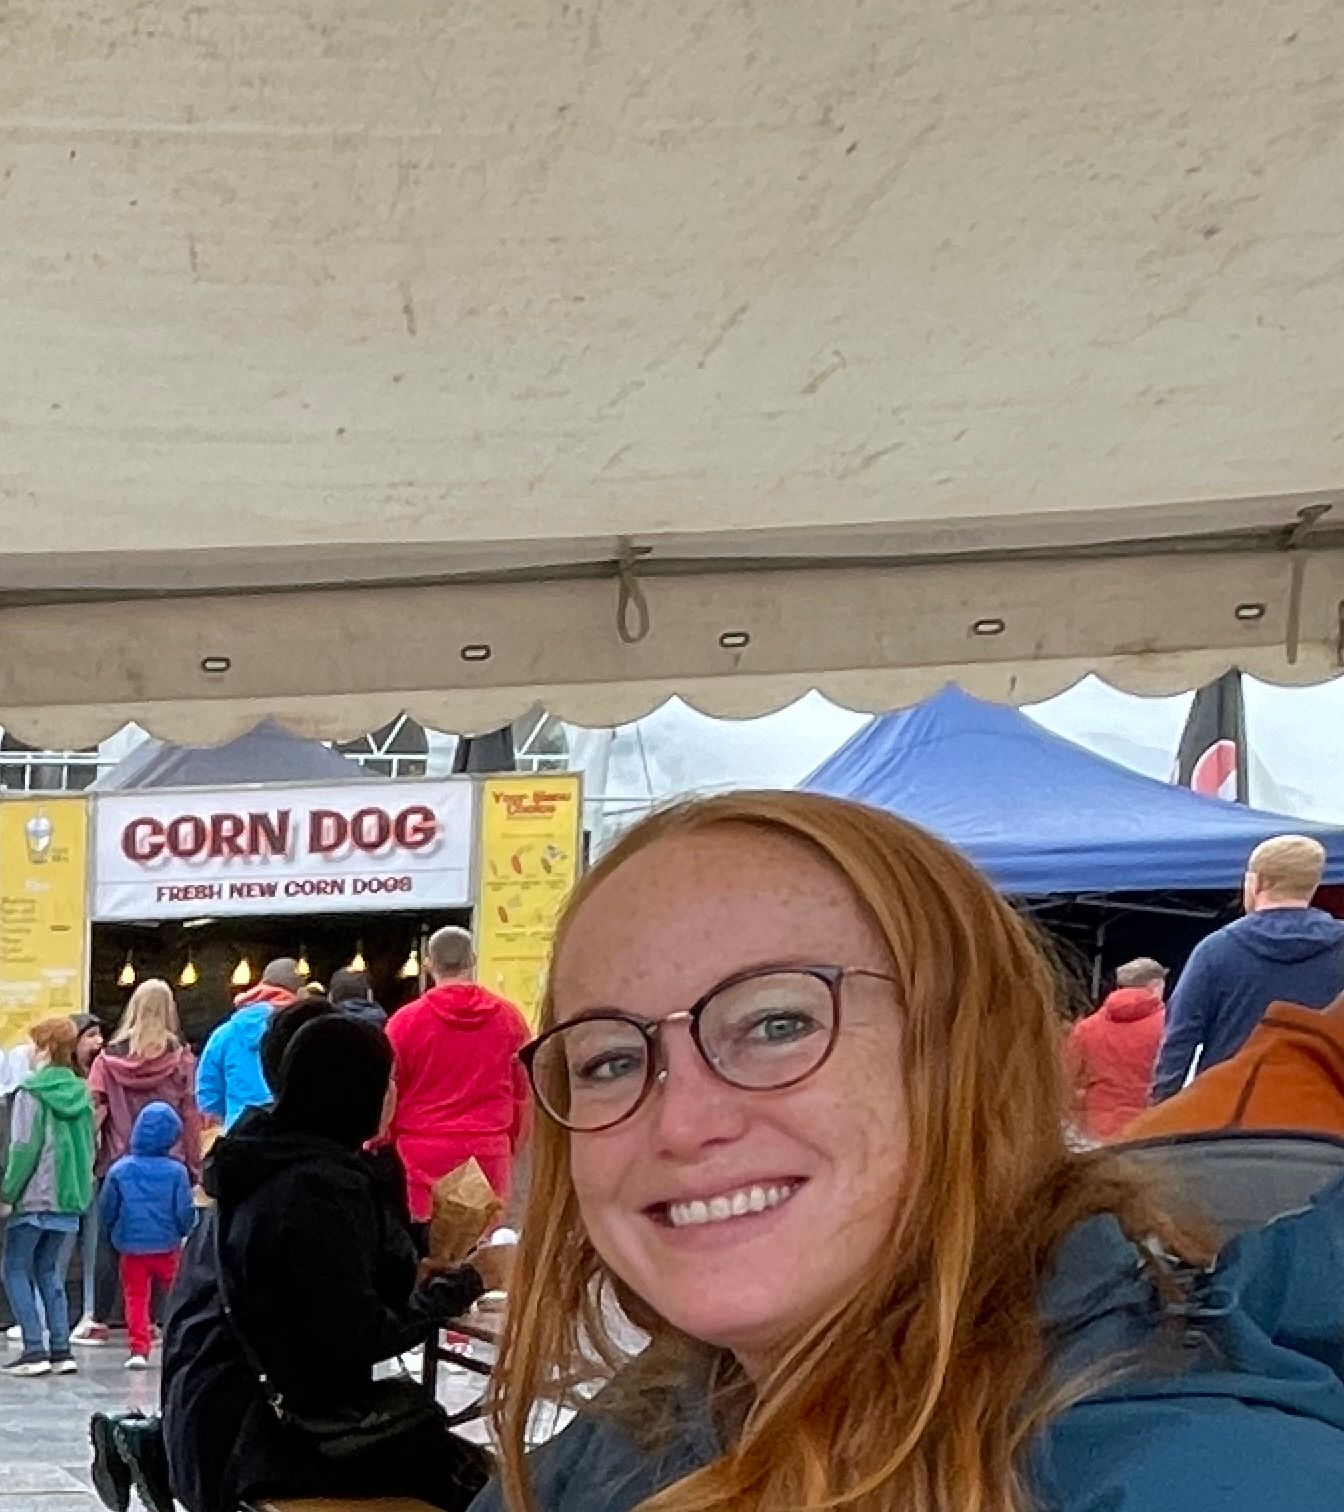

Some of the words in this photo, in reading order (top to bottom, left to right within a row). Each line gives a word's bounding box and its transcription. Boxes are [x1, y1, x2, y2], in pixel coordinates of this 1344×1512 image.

[120, 808, 292, 862] CORN
[308, 804, 440, 854] DOG
[156, 882, 224, 903] FRESH
[228, 880, 279, 900] NEW
[284, 878, 346, 898] CORN
